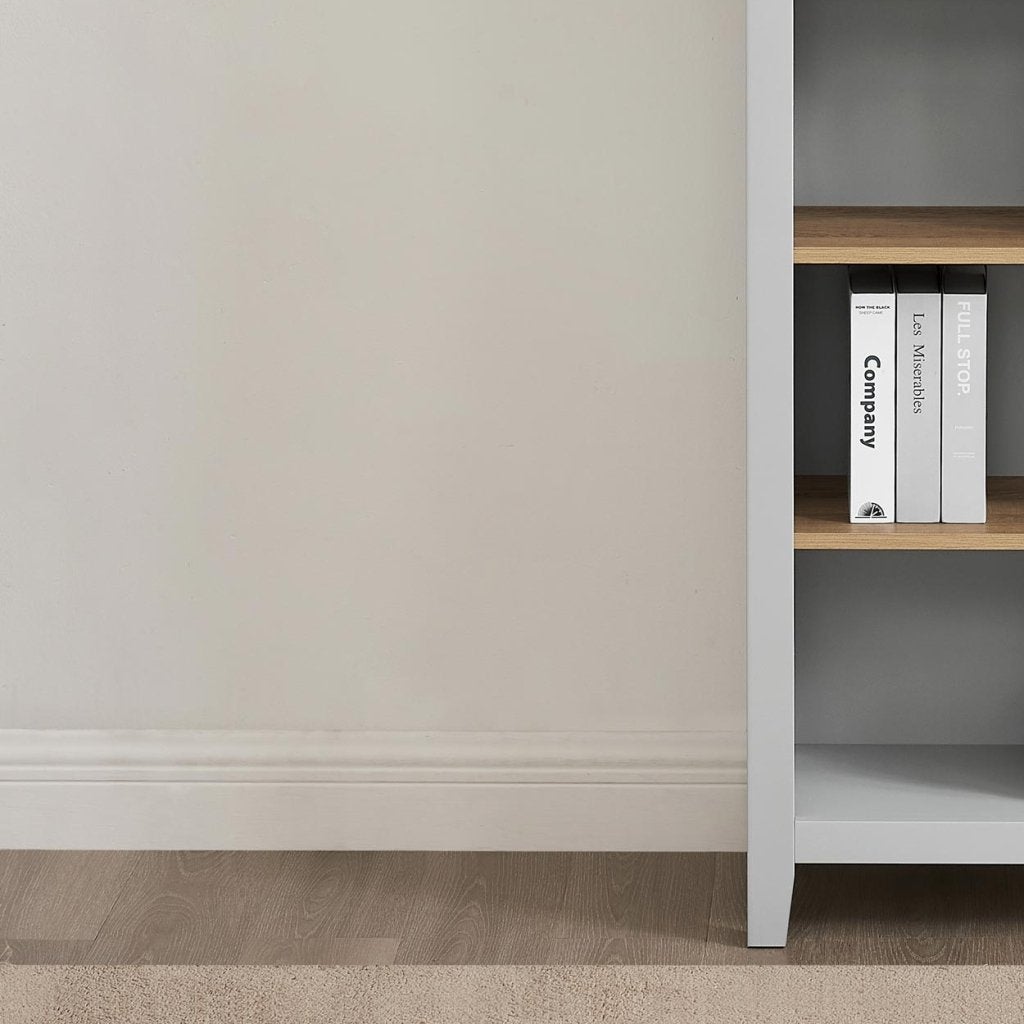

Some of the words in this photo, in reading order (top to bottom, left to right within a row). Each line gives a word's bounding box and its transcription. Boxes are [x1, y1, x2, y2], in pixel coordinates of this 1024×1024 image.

[912, 313, 925, 336] Les
[957, 301, 971, 344] FULL
[912, 344, 926, 414] Miserables
[957, 348, 971, 396] STOP.
[860, 355, 881, 449] Company
